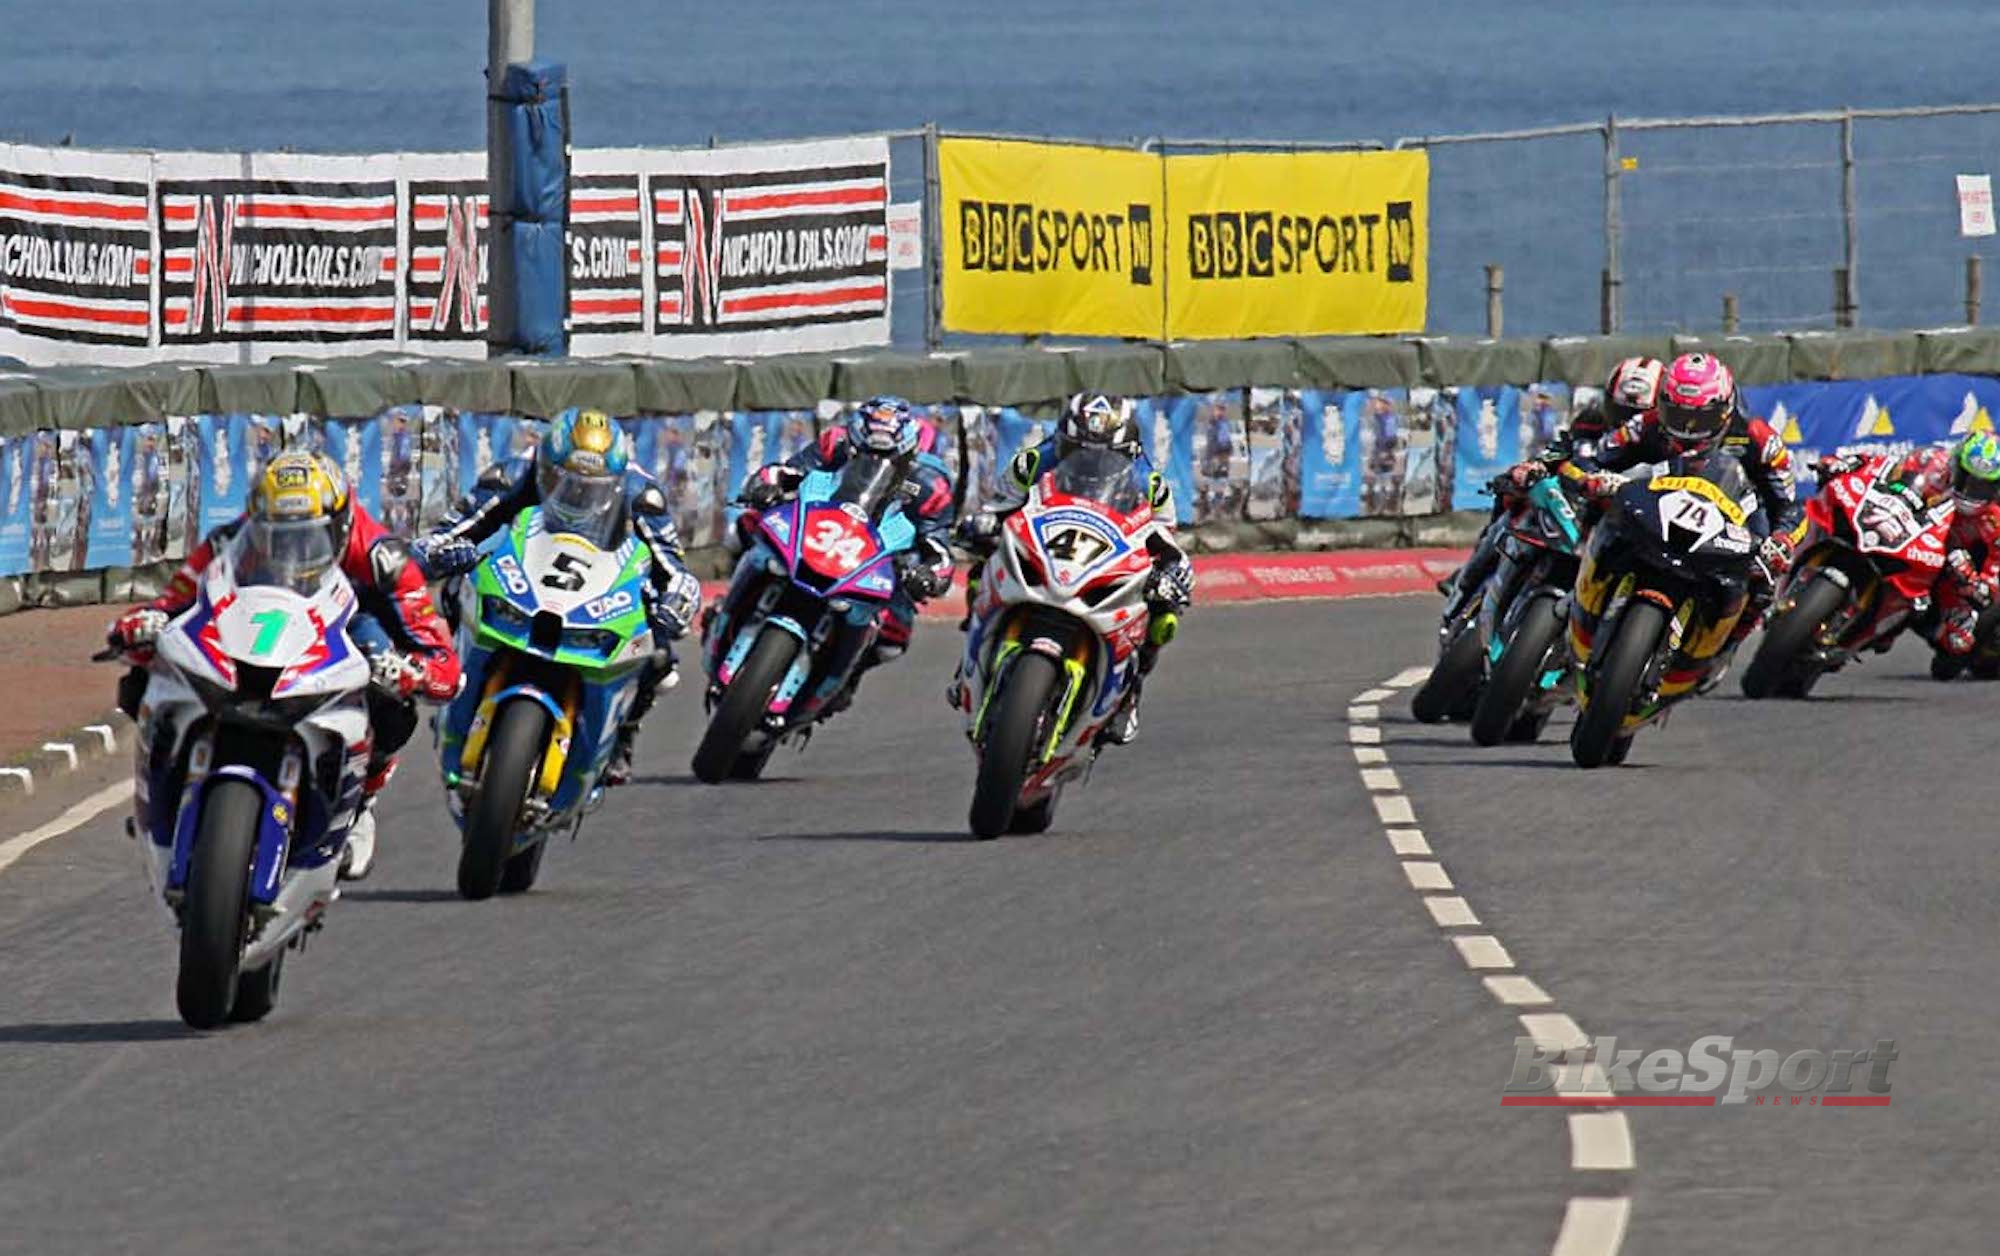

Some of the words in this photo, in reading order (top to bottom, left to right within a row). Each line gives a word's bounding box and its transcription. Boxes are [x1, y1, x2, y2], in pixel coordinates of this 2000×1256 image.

[1674, 498, 1709, 528] 74
[805, 519, 866, 569] 34
[540, 552, 592, 592] 5
[249, 608, 289, 656] 1
